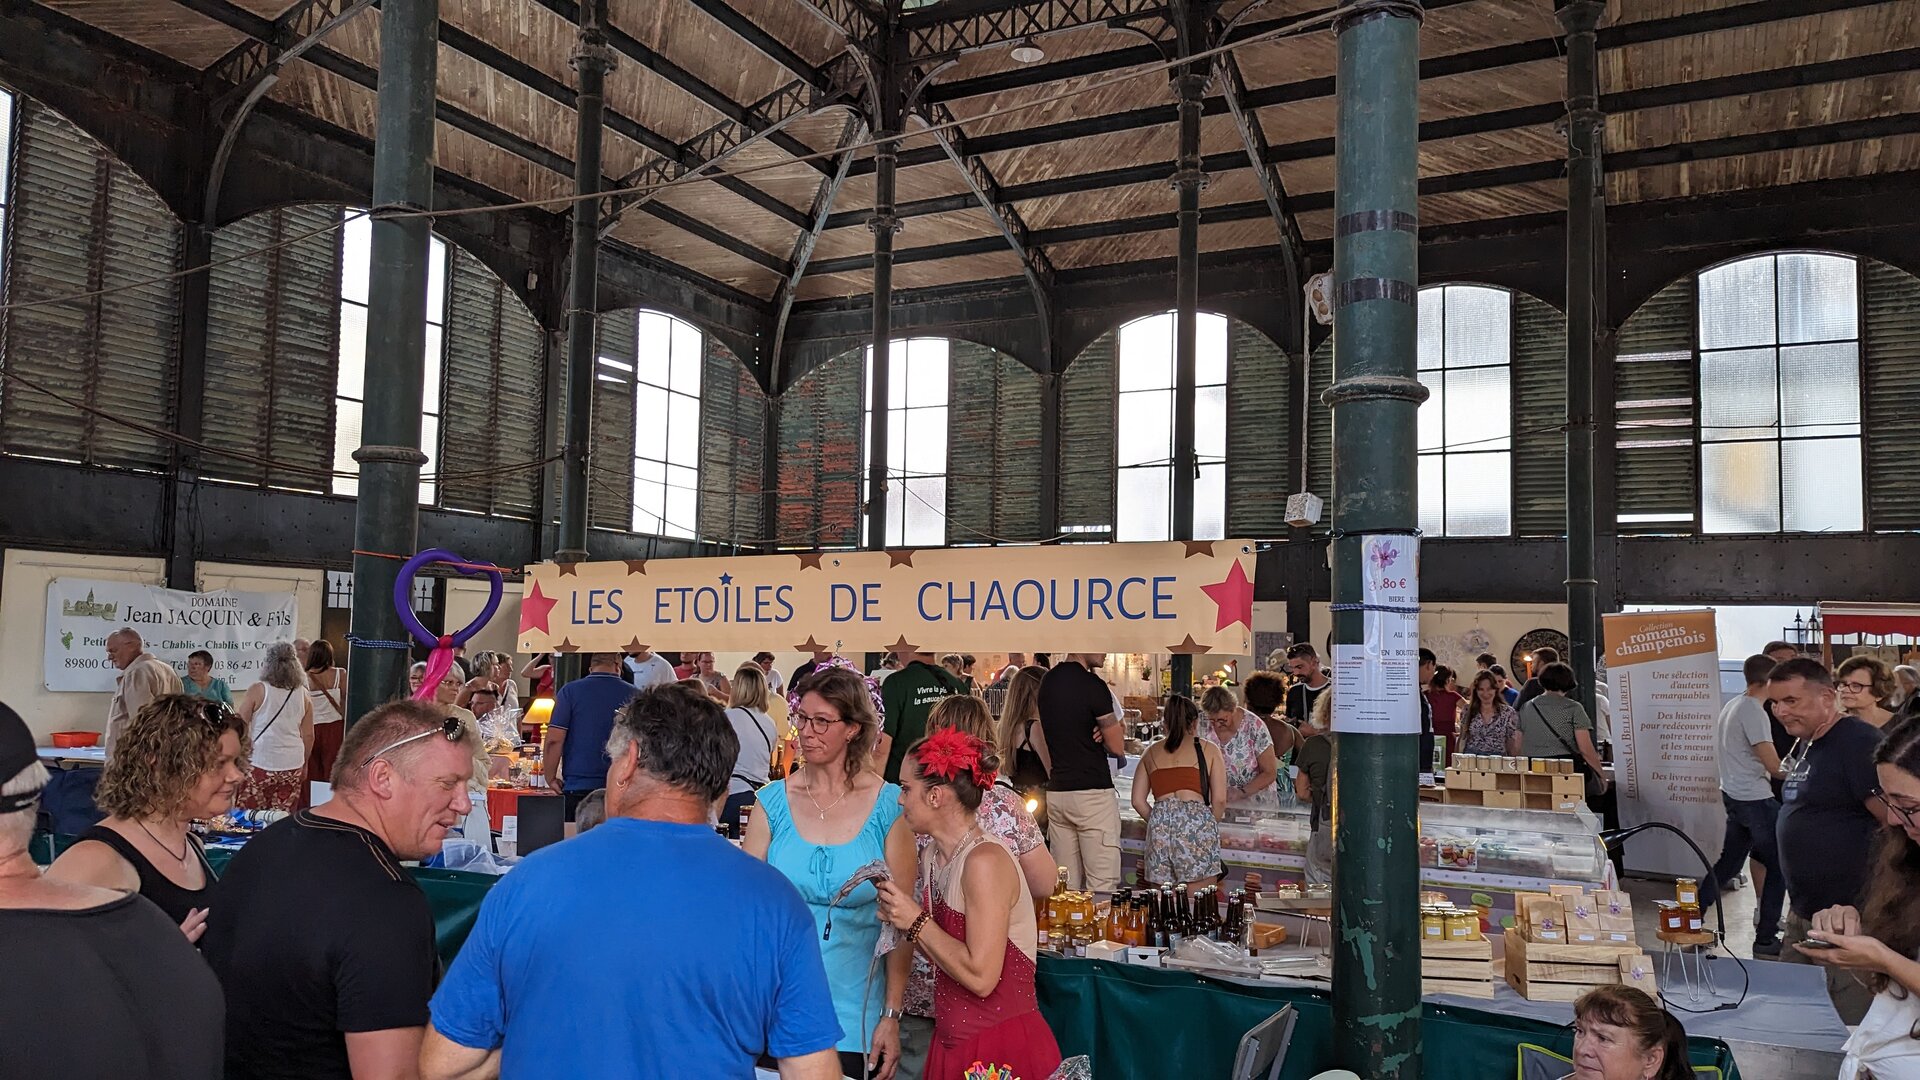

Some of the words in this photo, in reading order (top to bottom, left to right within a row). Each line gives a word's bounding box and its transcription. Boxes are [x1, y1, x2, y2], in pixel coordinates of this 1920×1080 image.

[191, 598, 238, 608] DOMAINE
[571, 589, 624, 625] LES
[655, 584, 795, 625] ETOILES
[830, 583, 882, 622] DE
[917, 576, 1177, 622] CHAOURCE
[124, 606, 162, 624] Jean
[168, 609, 244, 629] JACQUIN
[247, 612, 261, 627] &
[266, 611, 291, 626] Fils
[1639, 622, 1674, 633] Collection
[1630, 626, 1686, 644] romans
[162, 640, 195, 649] Chablis
[205, 640, 239, 650] Chablis
[1616, 630, 1706, 656] champenois
[65, 658, 98, 669] 89800
[215, 661, 224, 670] 03
[227, 660, 238, 670] 86
[241, 660, 252, 670] 42
[1671, 671, 1708, 679] sélection
[917, 686, 932, 694] Vivre
[1670, 681, 1710, 689] d'auteurs
[1651, 691, 1710, 701] remarquables
[1658, 712, 1673, 720] Des
[1675, 712, 1711, 720] histoires
[1640, 723, 1660, 731] pour
[1662, 722, 1712, 730] redécouvrir
[1671, 742, 1682, 750] les
[1662, 752, 1670, 760] de
[1652, 772, 1667, 780] Des
[1670, 773, 1691, 781] livres
[1668, 783, 1678, 791] de
